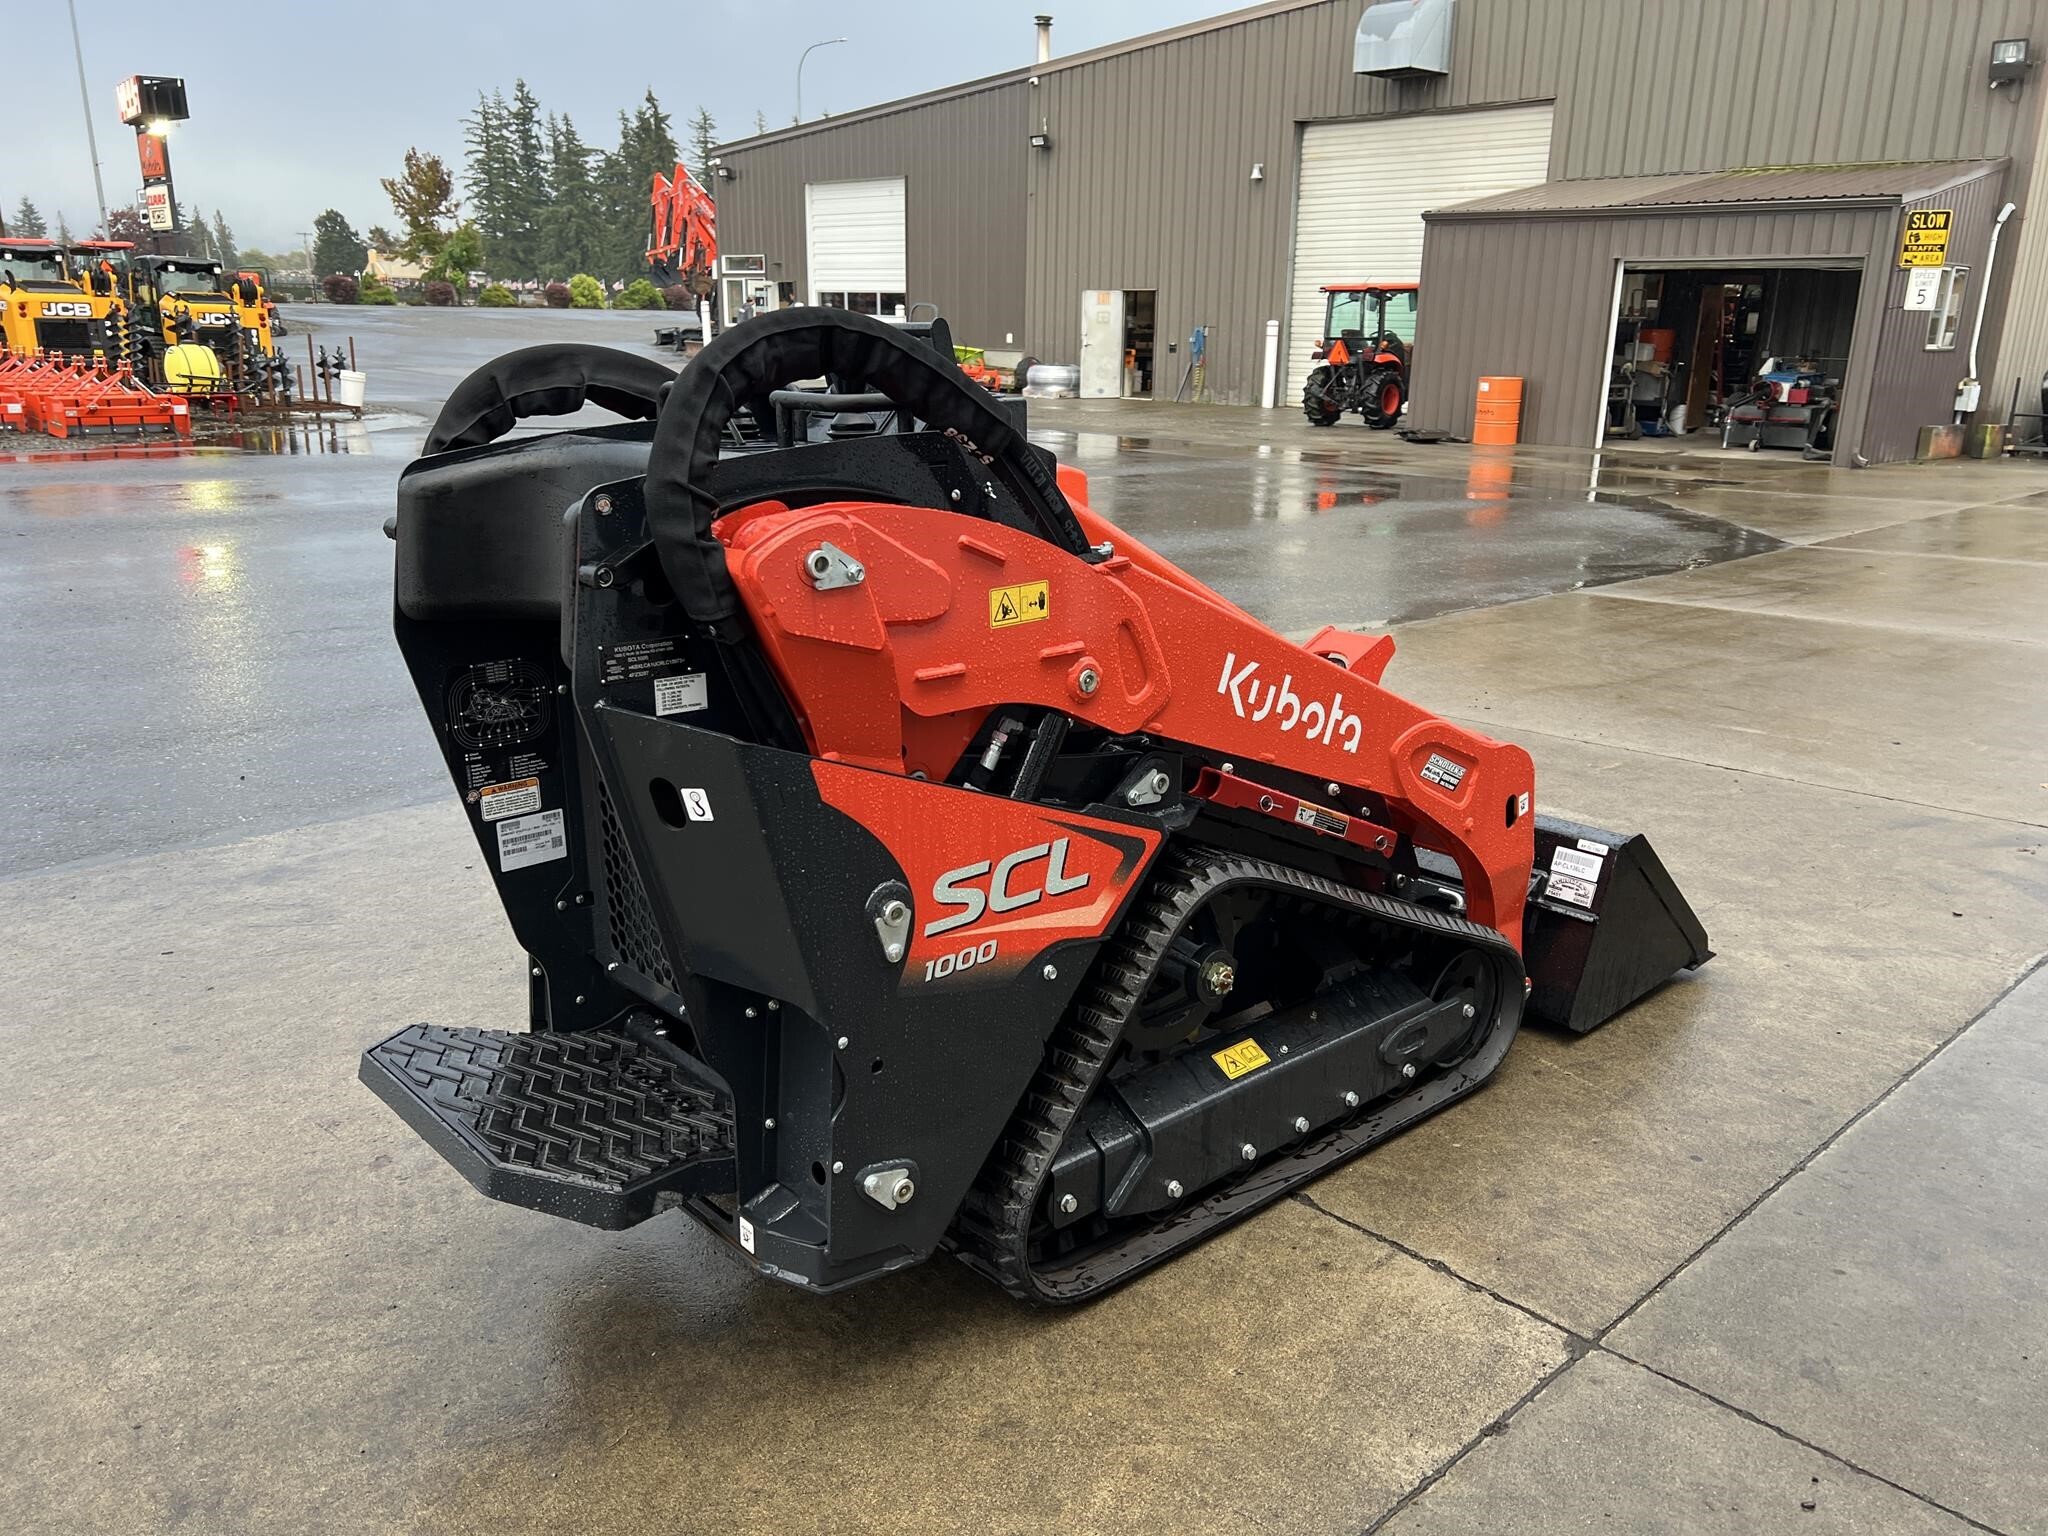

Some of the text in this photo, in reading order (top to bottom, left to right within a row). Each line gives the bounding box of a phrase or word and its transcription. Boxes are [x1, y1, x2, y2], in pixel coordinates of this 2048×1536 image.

[1912, 214, 1947, 229] SLOW
[1924, 232, 1943, 240] HIGH
[1920, 254, 1939, 262] AREA
[1916, 289, 1927, 305] 5
[42, 303, 92, 317] JCB
[1217, 652, 1362, 754] Kubota
[924, 837, 1090, 938] SCL
[925, 939, 998, 983] 1000
